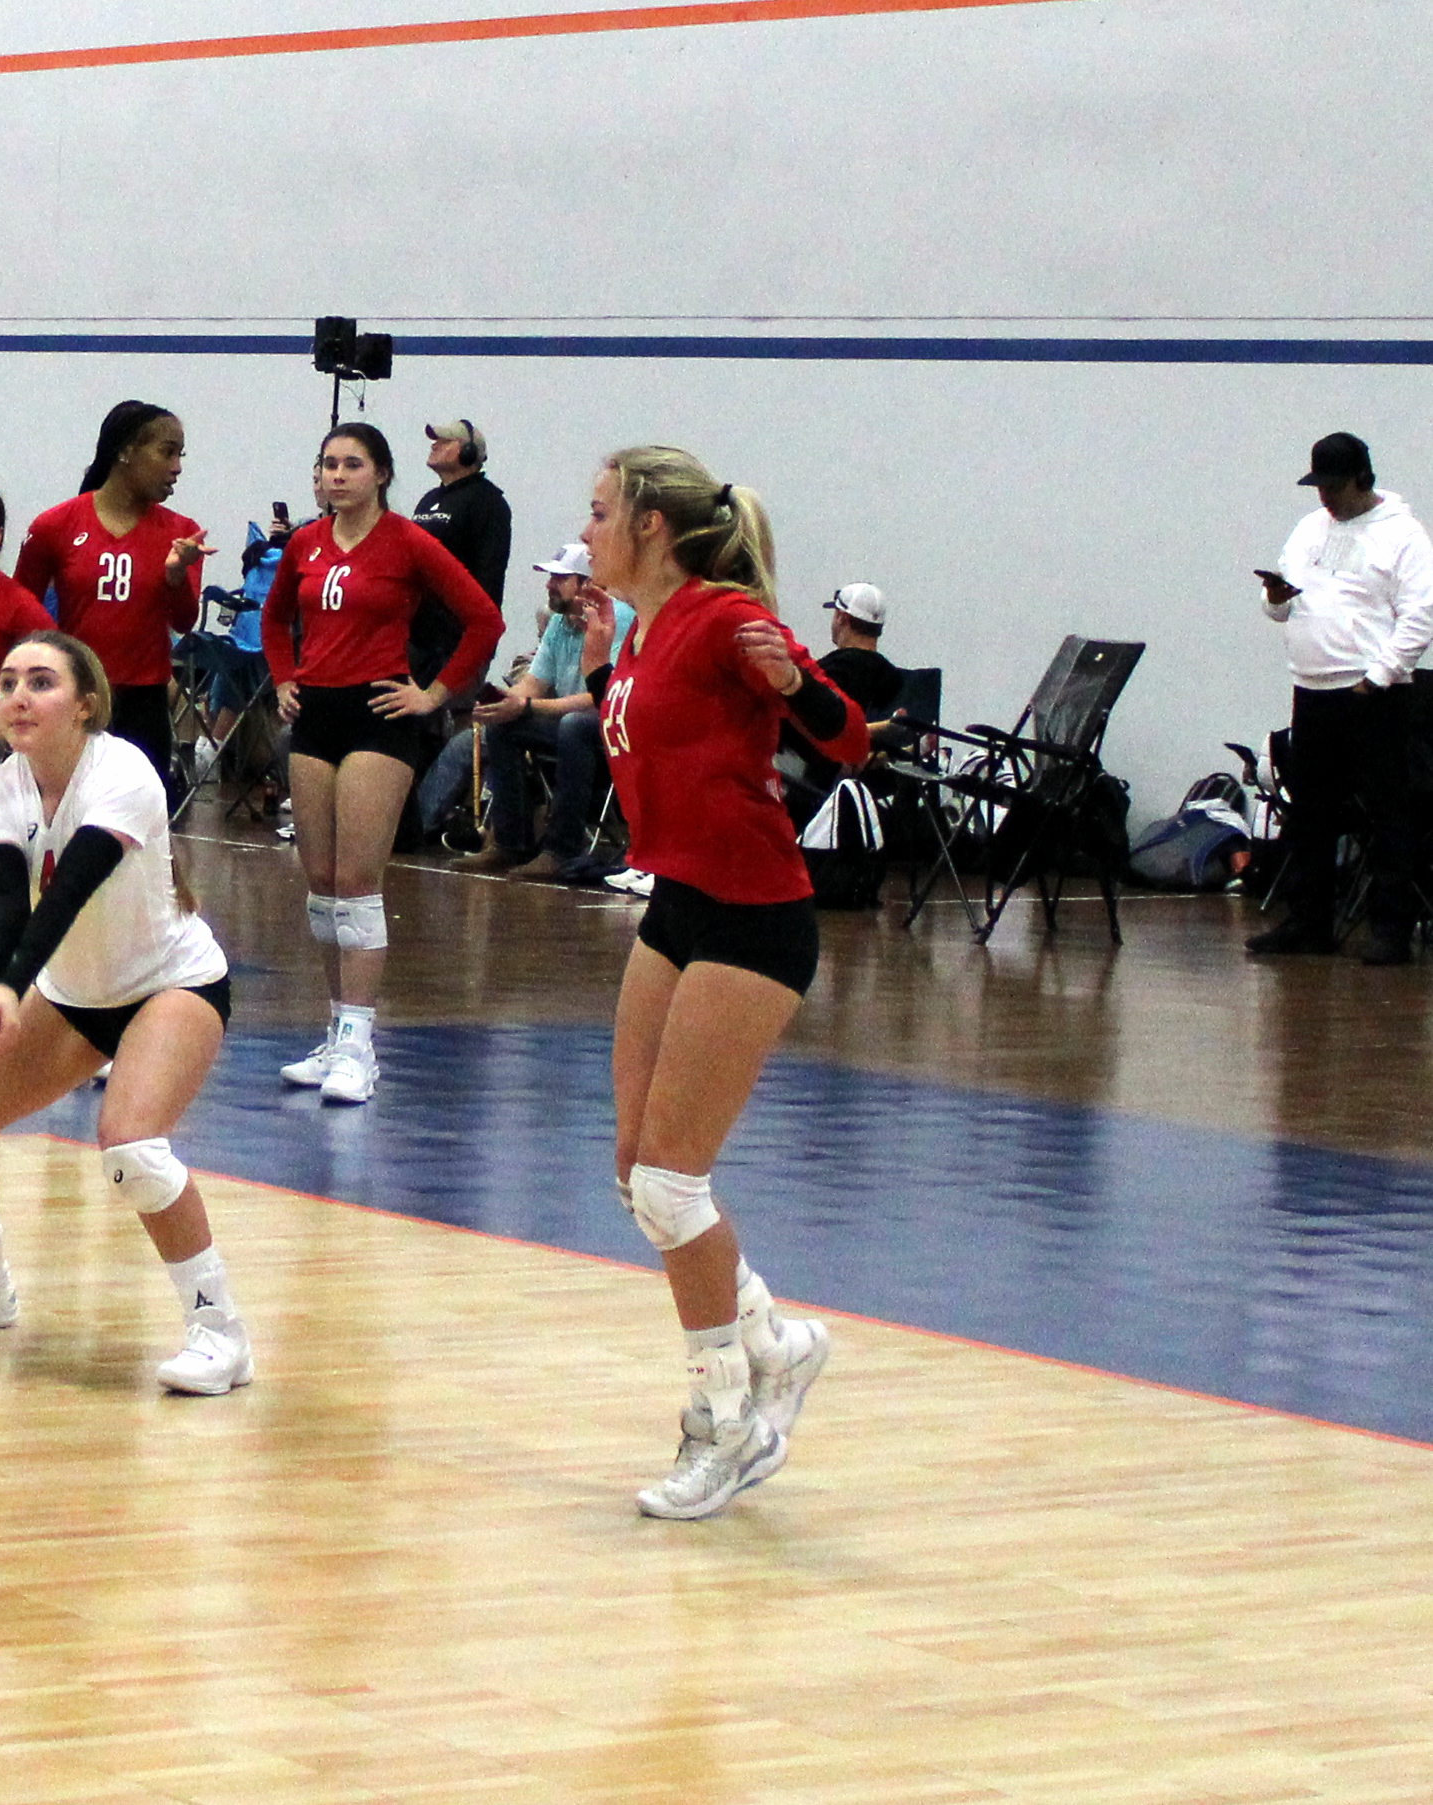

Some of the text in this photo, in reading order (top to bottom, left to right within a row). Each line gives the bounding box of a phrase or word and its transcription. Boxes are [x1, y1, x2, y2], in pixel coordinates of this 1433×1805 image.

[97, 552, 132, 601] 28
[321, 565, 351, 610] 16
[603, 676, 634, 757] 23
